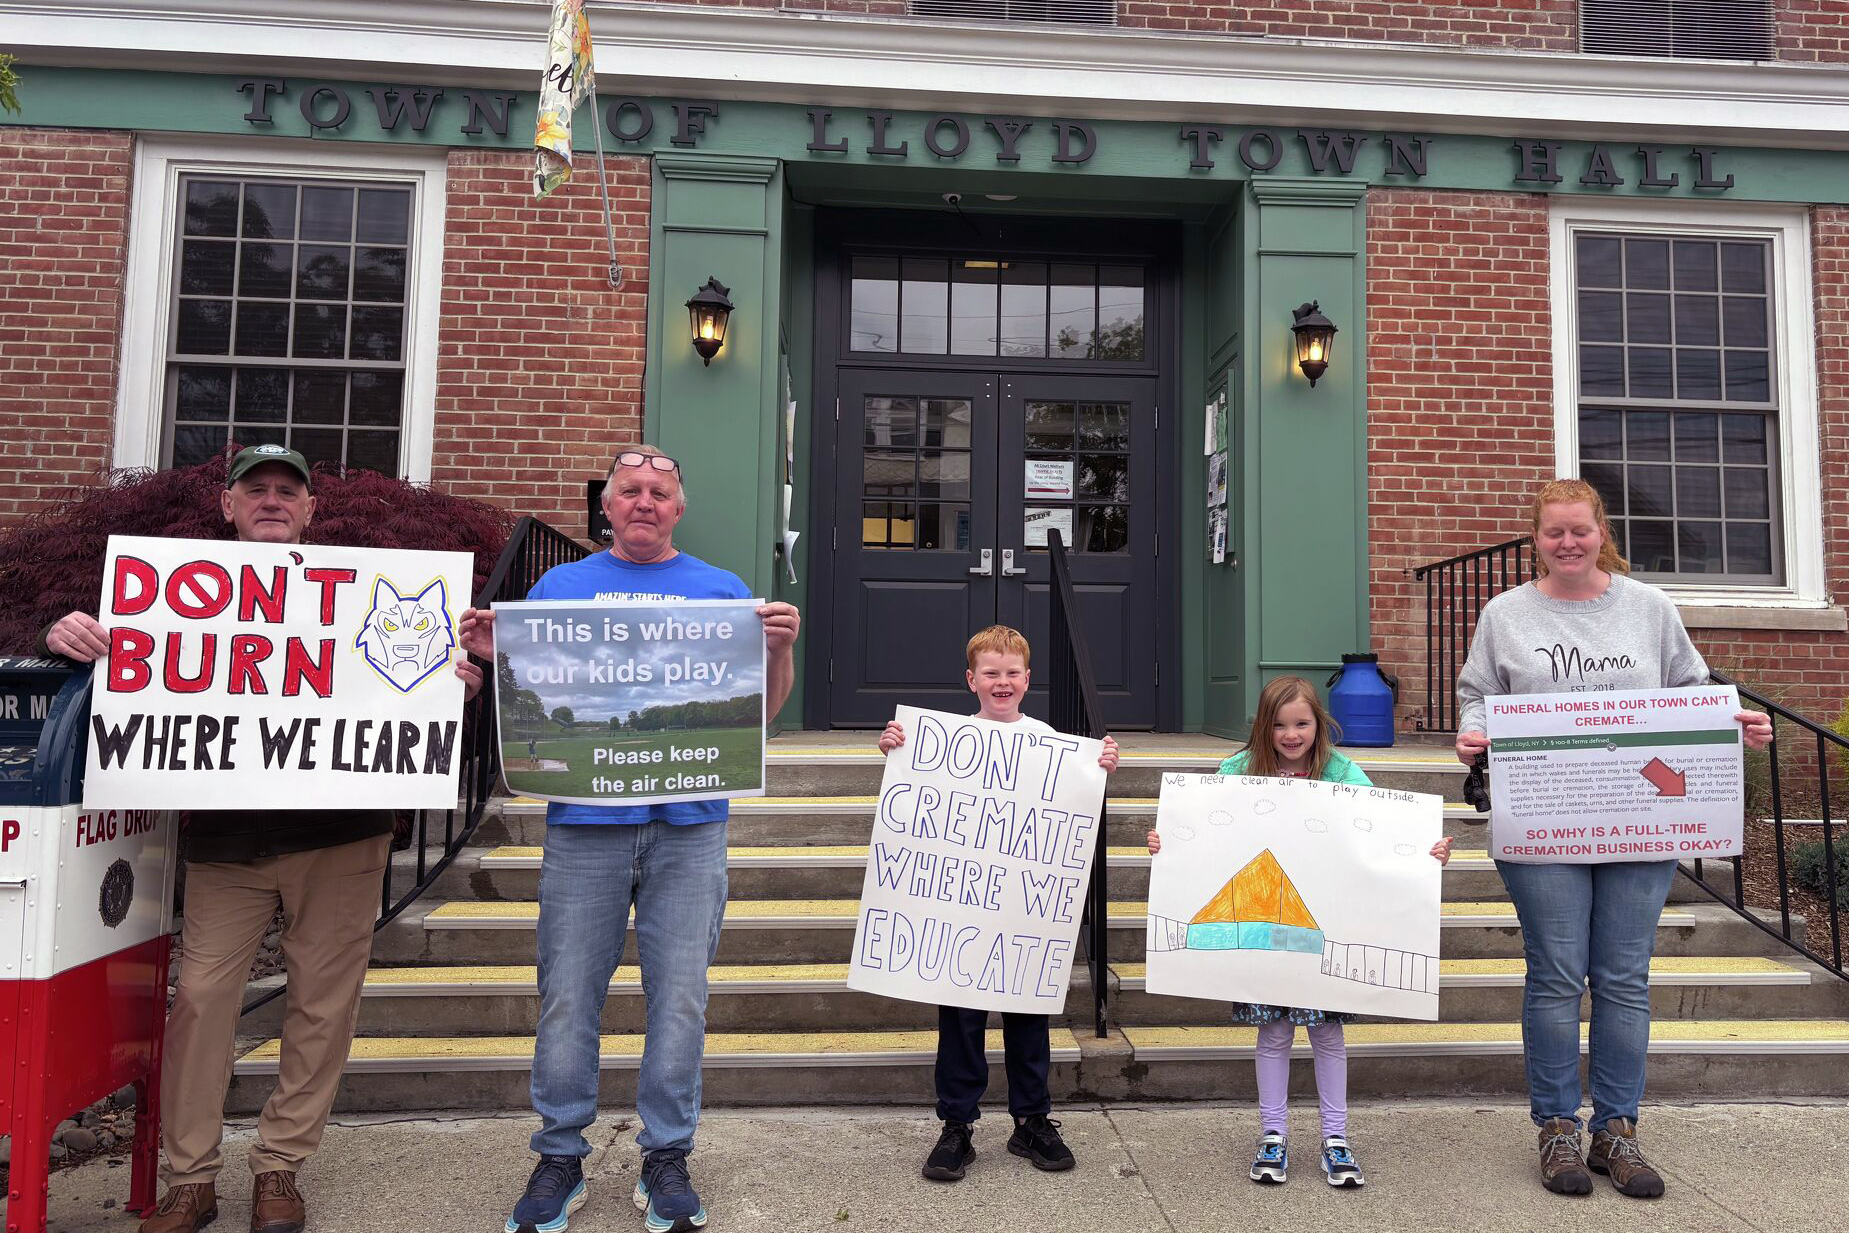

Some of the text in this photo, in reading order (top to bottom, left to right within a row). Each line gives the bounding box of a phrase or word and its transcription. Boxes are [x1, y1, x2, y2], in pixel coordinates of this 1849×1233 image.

[236, 80, 1734, 188] TOWN OF LLOYD TOWN HALL
[112, 551, 357, 626] DON'T
[524, 616, 733, 643] This is where
[14, 659, 69, 668] MAIL
[107, 627, 336, 698] BURN
[526, 657, 733, 687] our kids play.
[1535, 644, 1636, 682] Mama
[1594, 683, 1614, 692] 2018
[1494, 696, 1729, 714] FUNERAL HOMES IN OUR TOWN CAN'T
[1575, 715, 1646, 726] CREMATE...
[92, 714, 458, 776] WHERE WE LEARN
[593, 745, 719, 765] Please keep
[912, 715, 1079, 802] DON'T
[592, 772, 725, 793] the air clean.
[1165, 774, 1186, 787] We
[1200, 774, 1226, 784] need
[1241, 776, 1268, 785] clean
[1279, 778, 1294, 786] air
[1332, 780, 1359, 798] play
[1370, 788, 1419, 804] outside.
[76, 810, 160, 847] FLAG DROP
[881, 783, 1094, 869] CREMATE
[1526, 823, 1707, 840] SO WHY IS A FULL-TIME
[1503, 839, 1732, 855] CREMATION BUSINESS OKAY?
[875, 842, 1080, 923] WHERE WE
[861, 908, 1070, 997] EDUCATE
